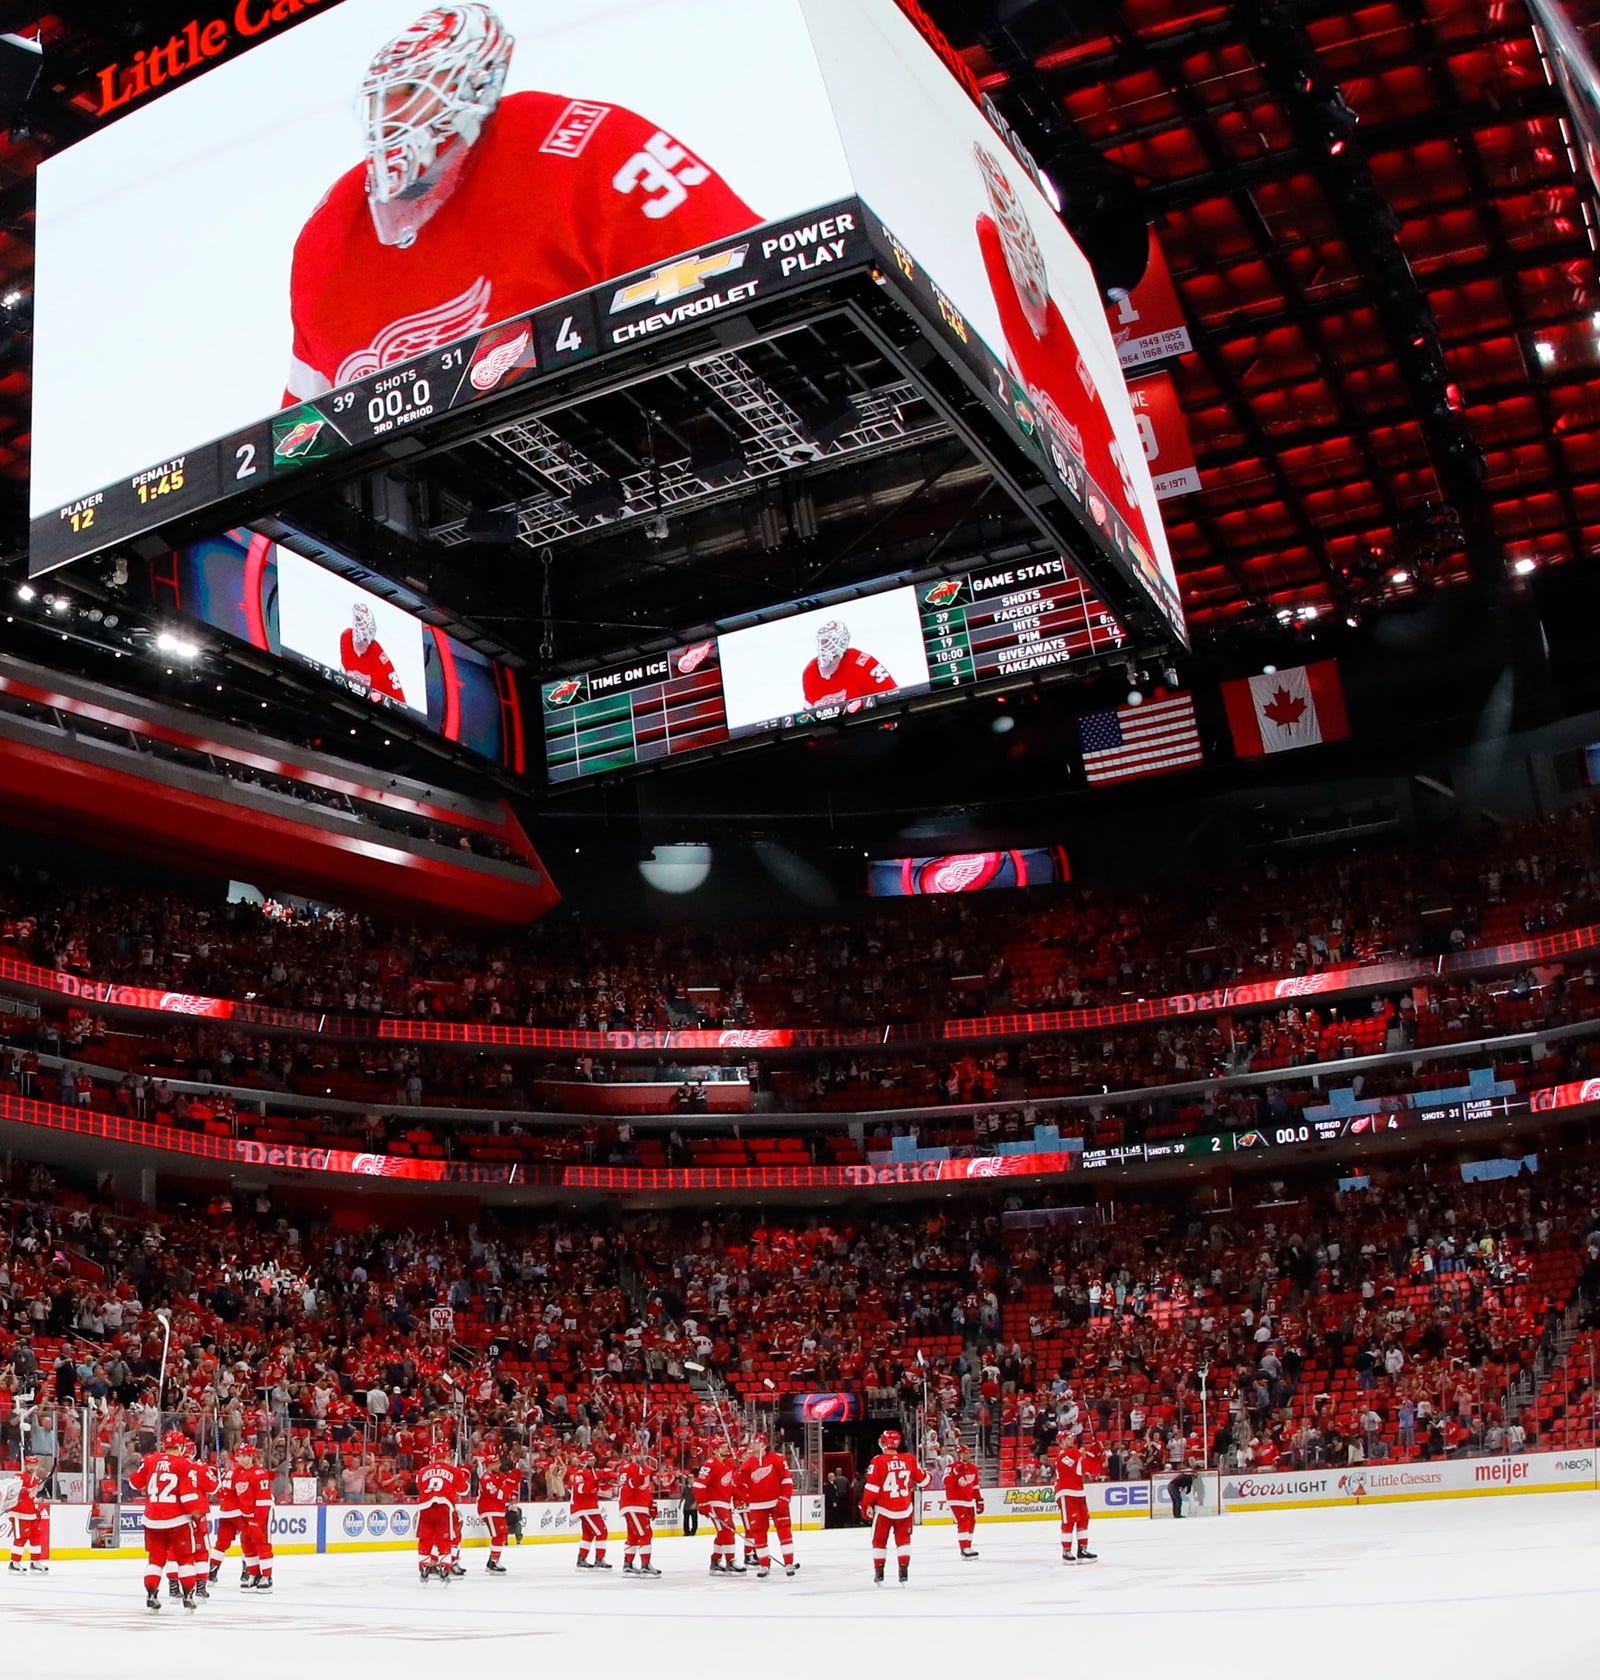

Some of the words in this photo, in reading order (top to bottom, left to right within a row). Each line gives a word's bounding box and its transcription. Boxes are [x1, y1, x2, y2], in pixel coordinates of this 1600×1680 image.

[96, 17, 228, 117] Little
[612, 130, 711, 219] 35
[761, 213, 855, 259] POWER
[780, 239, 846, 277] PLAY
[612, 279, 760, 345] CHEVROLET
[555, 316, 582, 353] 4
[1138, 333, 1160, 350] 1949
[1161, 330, 1182, 345] 1955
[1164, 340, 1186, 355] 1969
[333, 392, 356, 414] 39
[374, 369, 418, 395] SHOTS
[440, 348, 464, 371] 31
[367, 380, 431, 424] 00.0
[372, 419, 394, 436] 3RD
[396, 404, 434, 427] PERIOD
[132, 456, 186, 489] PENALTY
[235, 443, 257, 480] 2
[137, 470, 184, 504] 1:45
[1168, 476, 1188, 490] 1971
[60, 491, 104, 521] PLAYER
[69, 508, 95, 533] 12
[972, 572, 1015, 592] GAME
[1016, 560, 1062, 582] STATS
[935, 612, 949, 624] 39
[1001, 589, 1041, 607] SHOTS
[937, 625, 950, 636] 31
[992, 600, 1055, 623] FACEOFFS
[935, 649, 964, 663] 10:00
[1017, 630, 1041, 645] PIM
[940, 637, 953, 648] 19
[1012, 617, 1041, 632] HITS
[950, 662, 958, 673] 5
[998, 638, 1066, 662] GIVEAWAYS
[1106, 625, 1120, 637] 14
[952, 676, 960, 686] 3
[997, 650, 1070, 676] TAKEAWAYS
[1114, 638, 1123, 649] 7
[324, 666, 332, 680] 2
[590, 672, 622, 691] TIME
[624, 667, 643, 682] ON
[646, 660, 668, 676] ICE
[784, 716, 792, 727] 2
[865, 697, 874, 708] 4
[1421, 1110, 1445, 1121] SHOTS
[1448, 1107, 1460, 1119] 31
[1466, 1099, 1491, 1110] PLAYER
[1467, 1109, 1492, 1120] PLAYER
[1211, 1137, 1221, 1152] 2
[1275, 1126, 1309, 1145] 00.0
[1314, 1120, 1341, 1131] PERIOD
[1387, 1114, 1398, 1129] 4
[1319, 1129, 1336, 1140] 3RD
[1082, 1149, 1107, 1159] PLAYER
[1110, 1147, 1120, 1156] 12
[1124, 1145, 1141, 1155] 1:45
[1148, 1146, 1171, 1157] SHOTS
[1173, 1144, 1185, 1154] 39
[1083, 1158, 1107, 1169] PLAYER
[155, 1460, 172, 1473] FRK
[886, 1460, 907, 1472] HELM
[1370, 1474, 1400, 1487] Little
[1400, 1472, 1442, 1487] Caesars
[1474, 1458, 1530, 1484] meijer
[147, 1472, 179, 1504] 42
[259, 1479, 270, 1490] 17
[882, 1470, 912, 1499] 43
[1237, 1479, 1285, 1498] Coors
[1286, 1479, 1328, 1494] LIGHT
